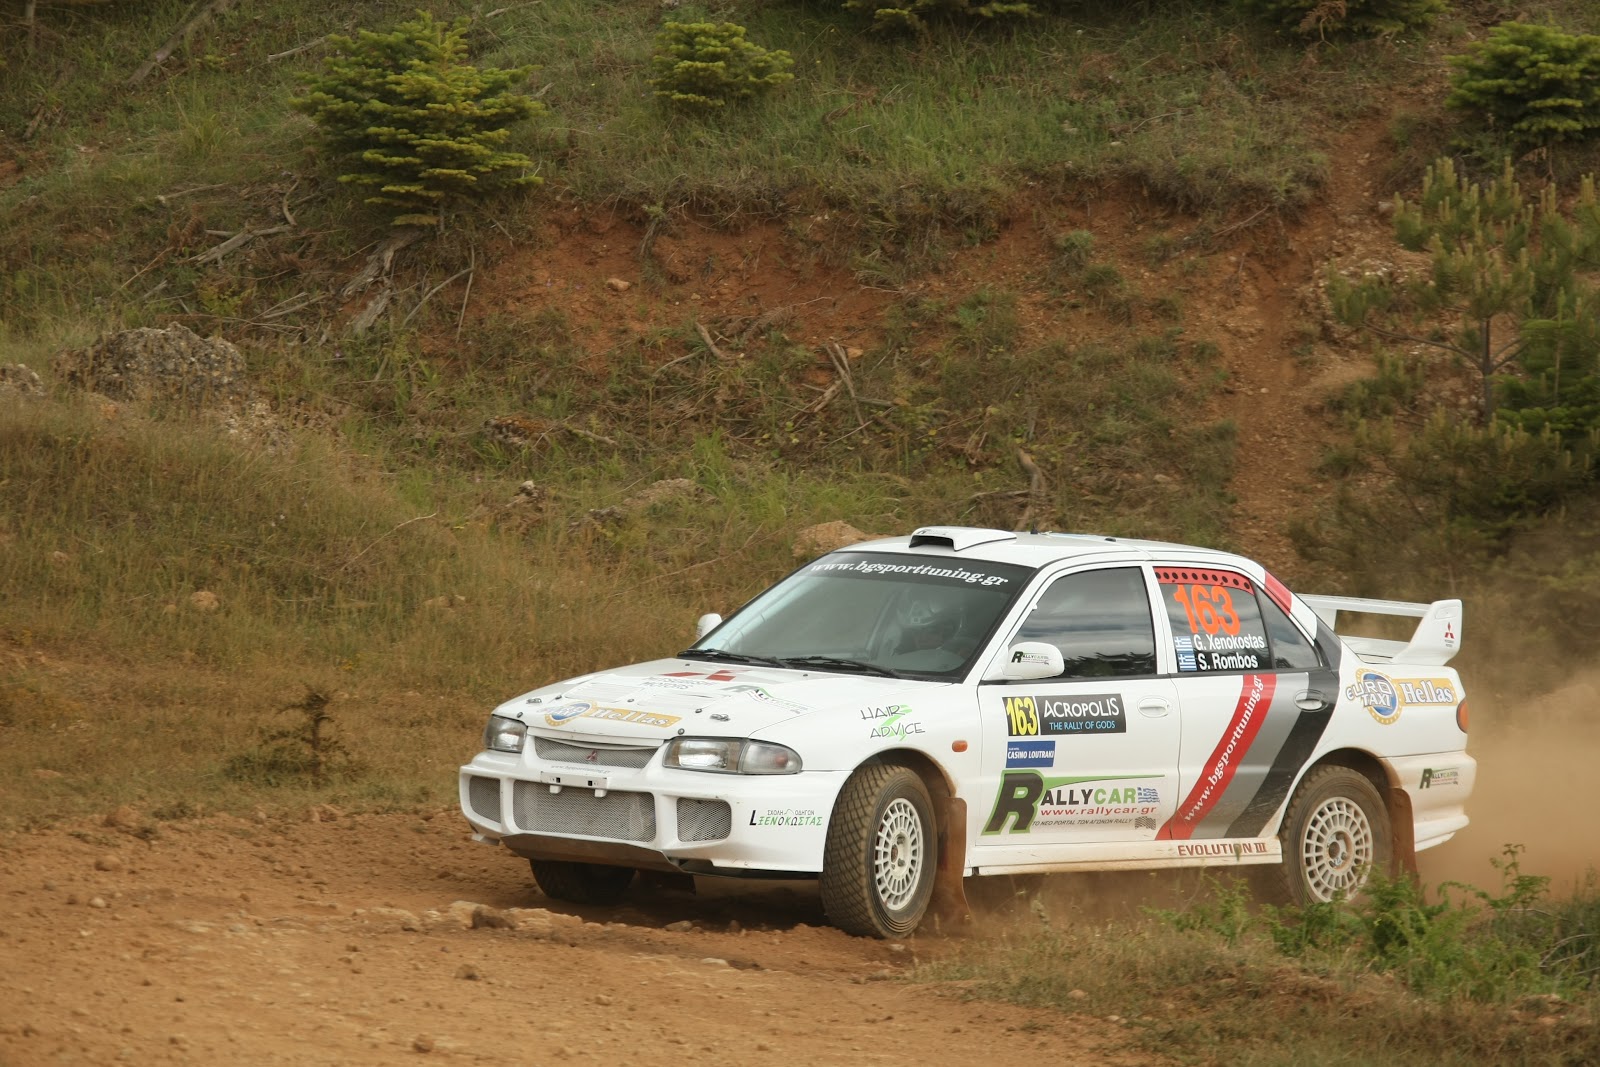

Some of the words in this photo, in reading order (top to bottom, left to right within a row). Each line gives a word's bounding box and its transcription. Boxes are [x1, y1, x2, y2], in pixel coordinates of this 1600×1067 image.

[811, 561, 1009, 586] www.bgsporttuning.gr
[1173, 584, 1241, 636] 163
[1193, 634, 1207, 650] G.
[1206, 634, 1265, 650] Xenokostas
[1198, 653, 1211, 670] S.
[1211, 653, 1258, 670] Rombos
[1361, 693, 1393, 708] TAXI
[1399, 680, 1455, 704] Hellas
[860, 705, 905, 720] HAIR
[1006, 697, 1039, 736] 163
[1043, 697, 1120, 718] ACROPOLIS
[589, 708, 670, 727] Hellas
[1049, 722, 1063, 731] THE
[1064, 721, 1083, 731] RALLY
[1085, 721, 1095, 730] OF
[1096, 720, 1116, 729] GODS
[870, 722, 926, 739] ADVICE
[1007, 751, 1028, 759] CASINO
[1028, 750, 1055, 759] LOUTRAKI
[1184, 675, 1263, 822] www.bgsporttuning.gr
[981, 769, 1135, 836] RALLYCAR
[1040, 806, 1157, 816] www.rallycar.gr
